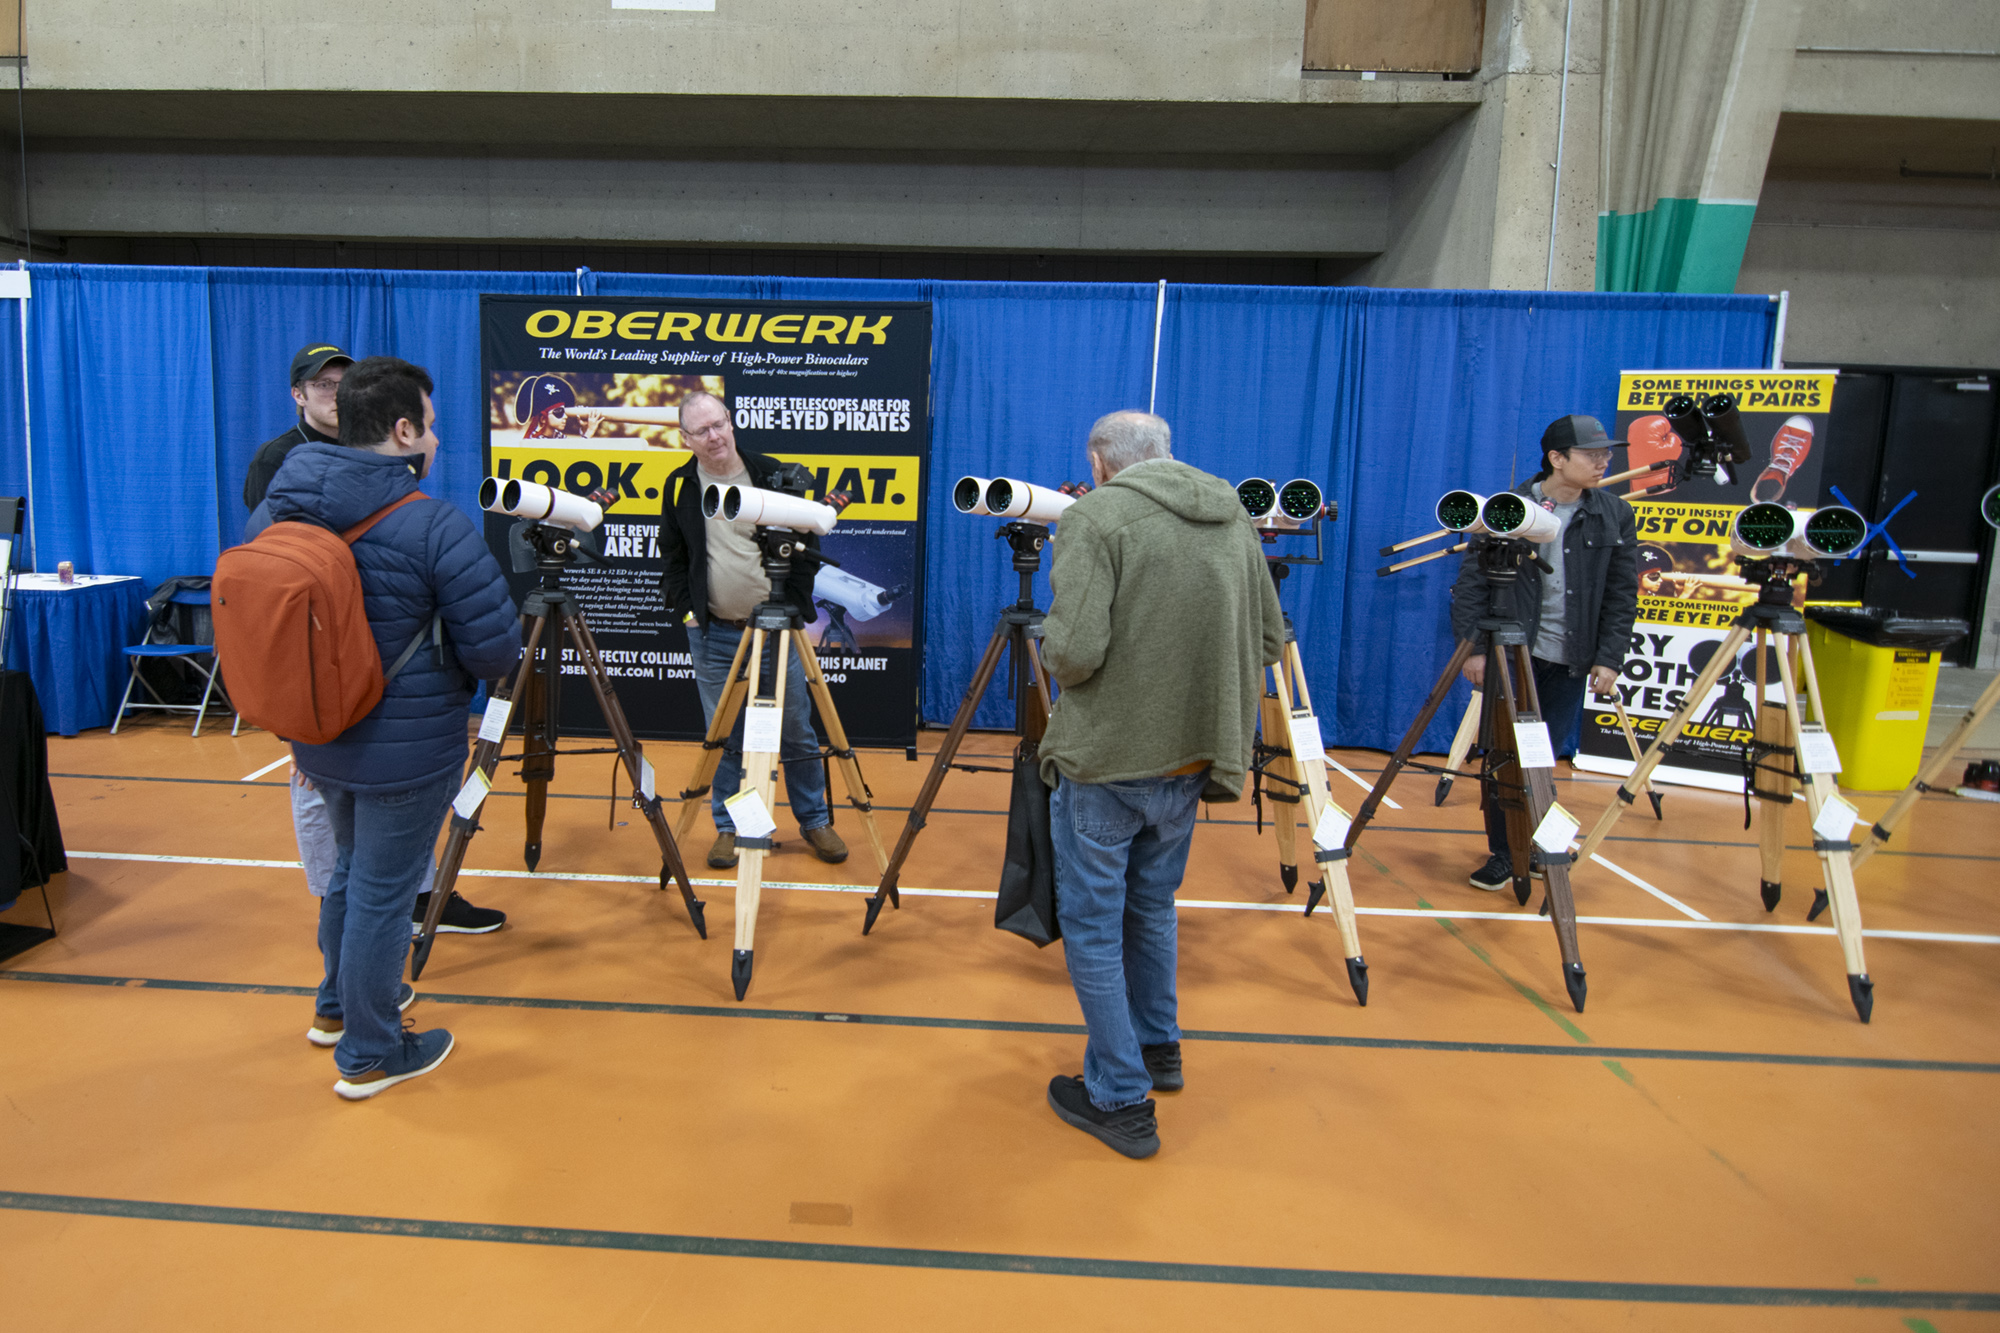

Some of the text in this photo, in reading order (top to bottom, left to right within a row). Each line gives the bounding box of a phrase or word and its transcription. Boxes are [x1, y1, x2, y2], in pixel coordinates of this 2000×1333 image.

[525, 309, 893, 345] OBERWERK
[539, 347, 869, 367] The World's Leading Supplier of High-Power Binoculars
[1631, 379, 1822, 391] SOME THINGS WORK
[735, 396, 911, 413] BECAUSE TELESCOPES ARE FOR
[1747, 392, 1822, 407] PAIRS
[735, 409, 911, 432] ONE-EYED PIRATES
[804, 466, 906, 505] HAT.
[1641, 506, 1654, 515] IF
[1656, 507, 1686, 517] YOU
[1689, 508, 1733, 519] INSIST
[603, 523, 660, 538] THE REVIE
[1682, 518, 1731, 538] ON
[603, 536, 644, 558] ARE
[1642, 598, 1667, 608] GOT
[1668, 600, 1740, 613] SOMETHING
[1636, 607, 1669, 621] REE
[1673, 610, 1712, 625] EYE
[1629, 632, 1675, 658] RY
[640, 651, 693, 666] COLLIMA
[842, 657, 888, 671] PLANET
[666, 668, 696, 680] DAYT
[1622, 658, 1697, 688] OTH
[1595, 713, 1755, 744] OBEWER
[1634, 731, 1656, 740] Leadin
